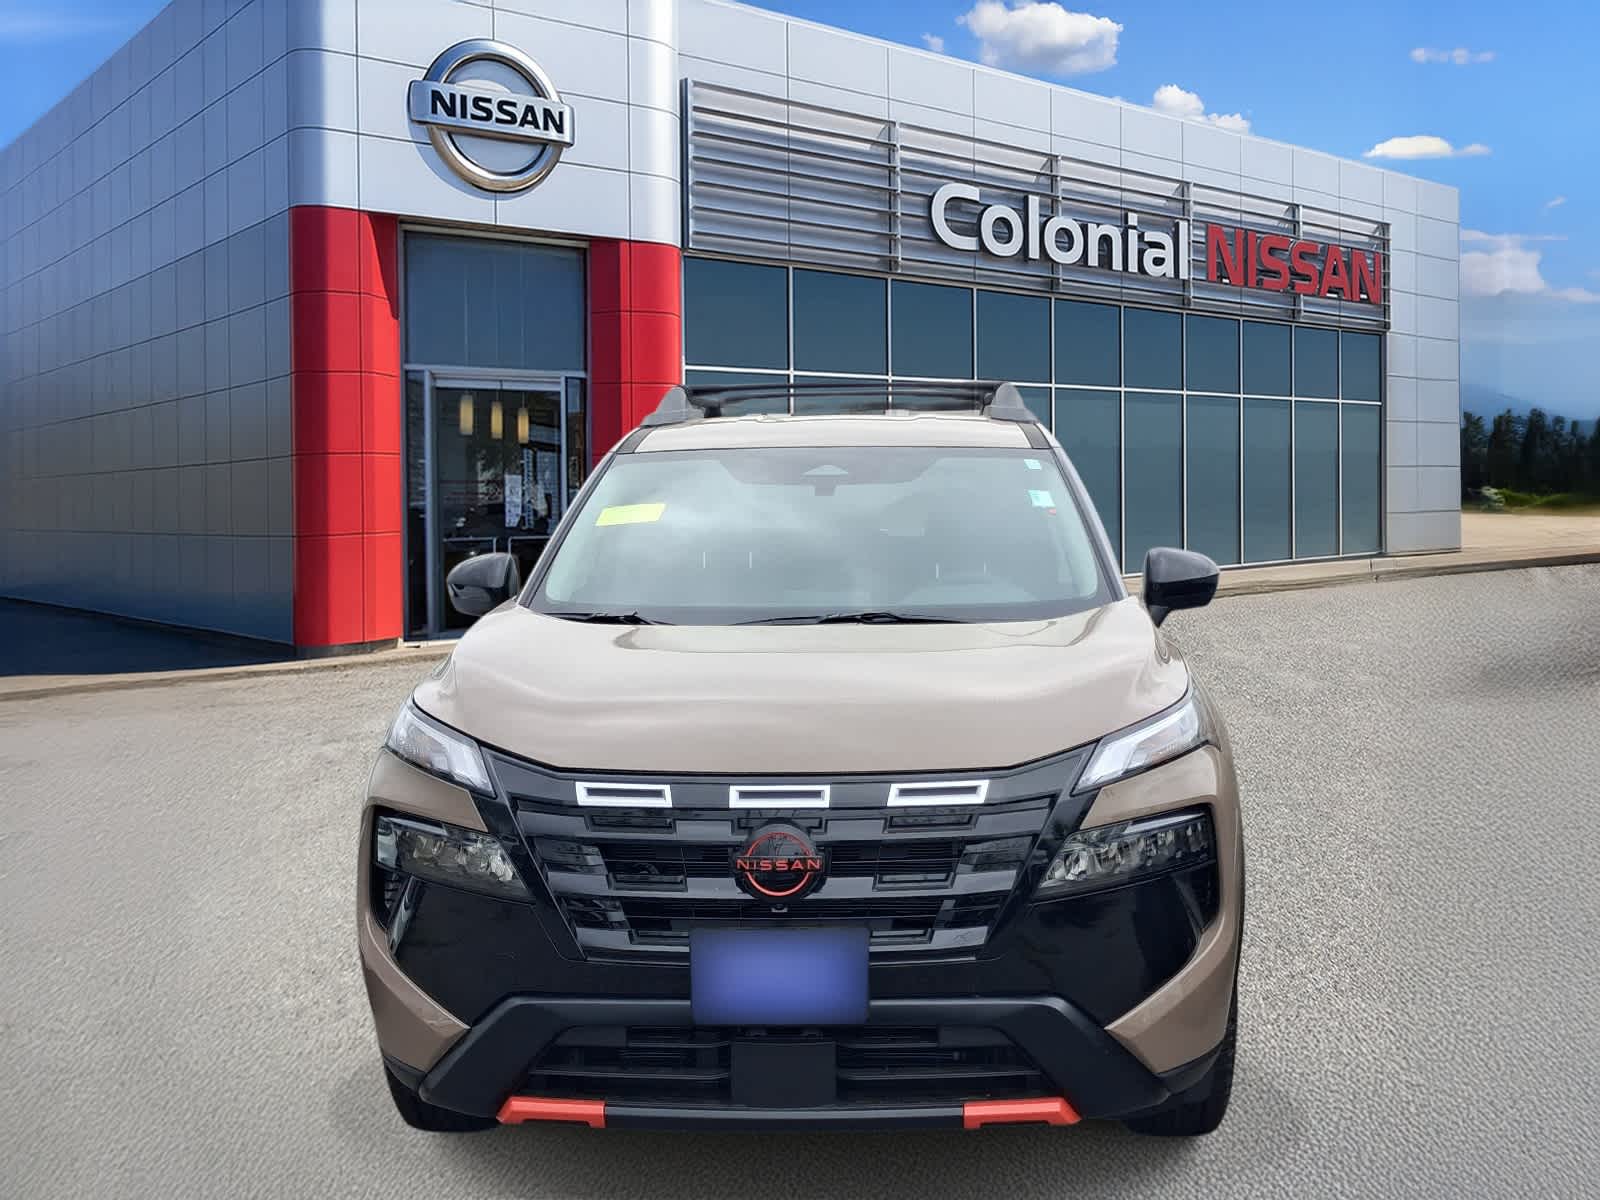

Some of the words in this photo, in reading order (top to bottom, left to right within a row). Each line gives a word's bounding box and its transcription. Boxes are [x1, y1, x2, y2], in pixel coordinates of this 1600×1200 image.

[430, 89, 565, 134] NISSAN
[930, 183, 1189, 280] Colonial
[1206, 223, 1383, 304] NISSAN
[736, 859, 821, 871] NISSAN
